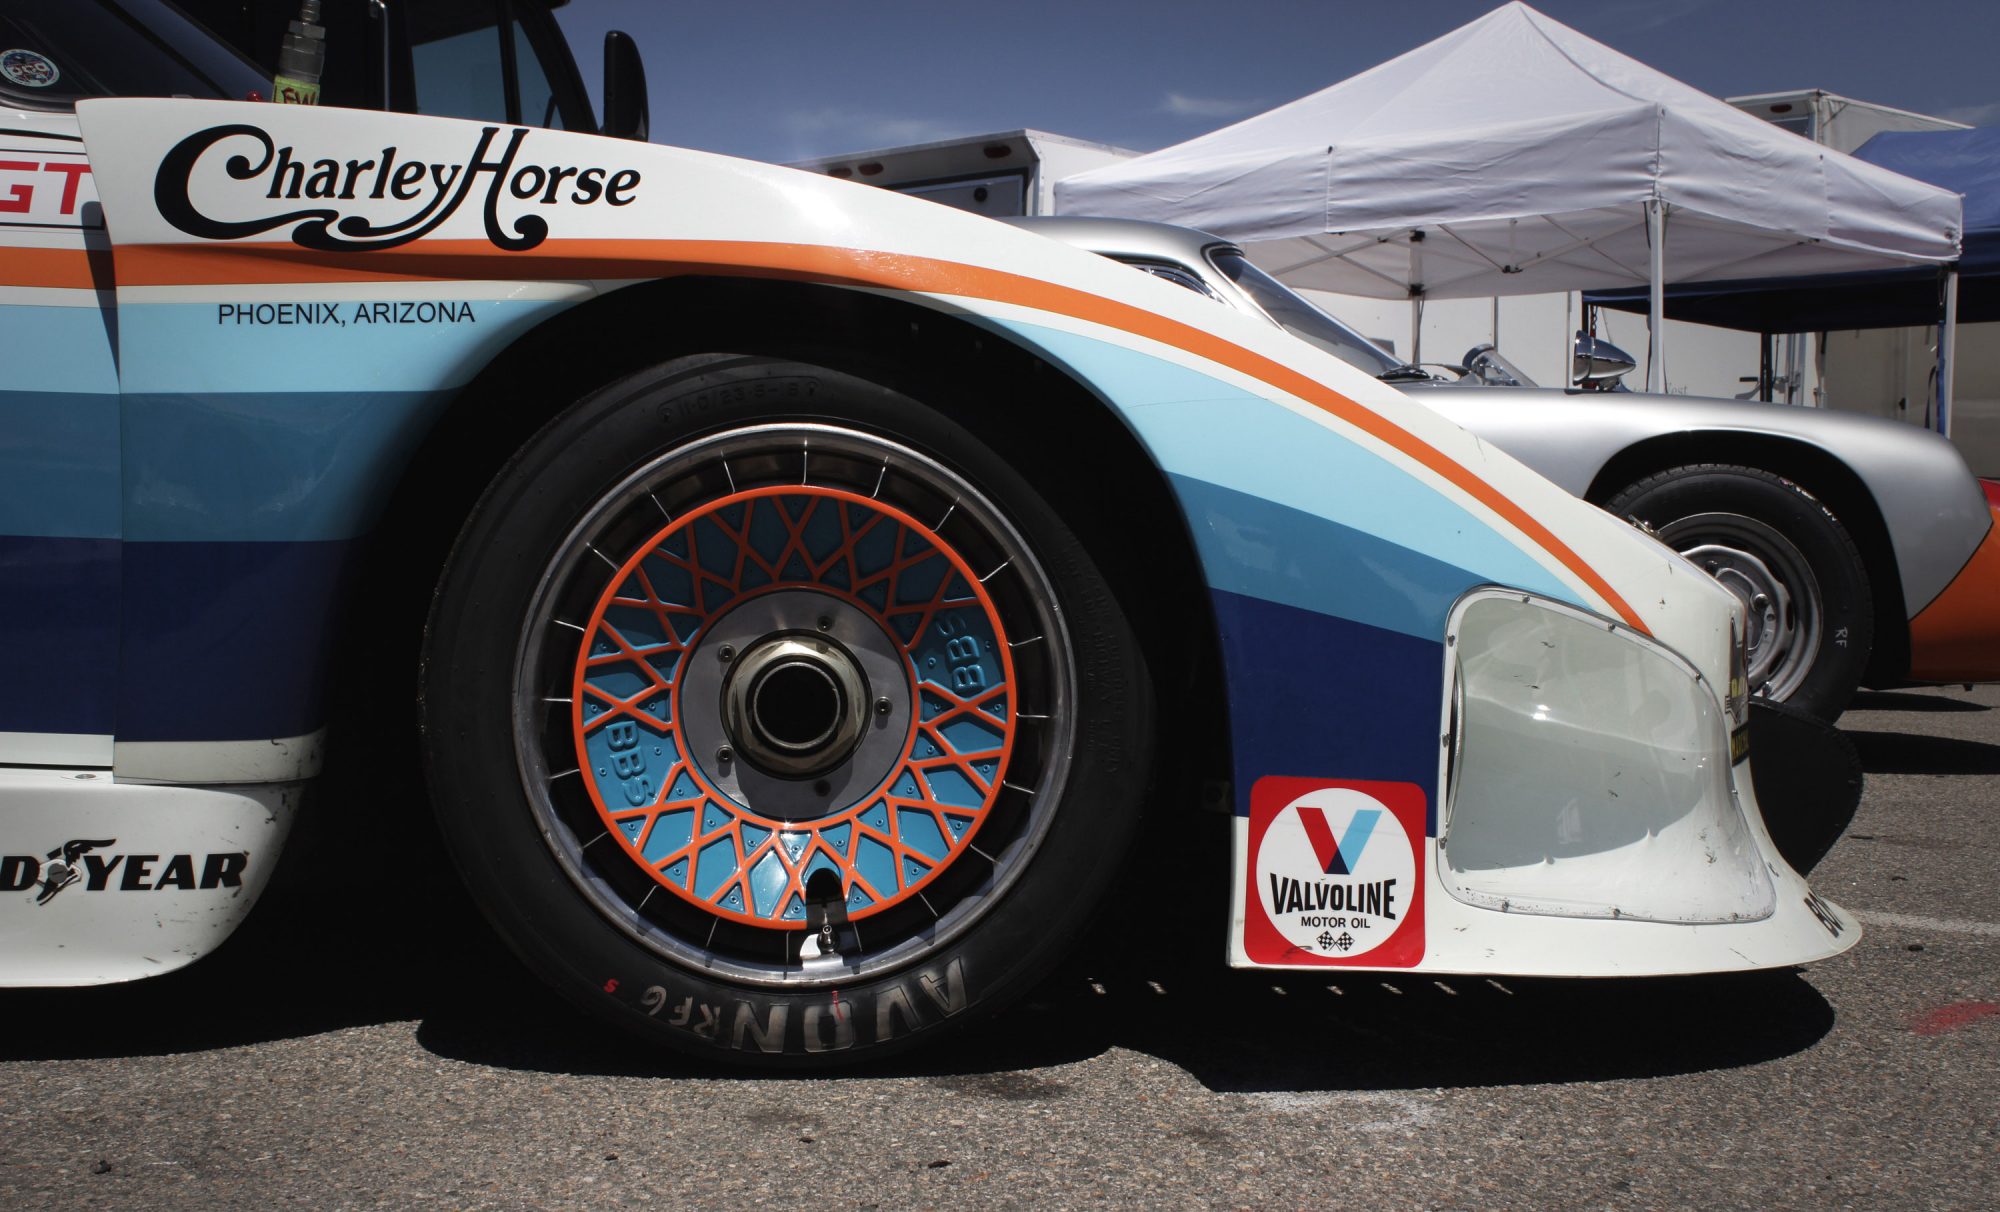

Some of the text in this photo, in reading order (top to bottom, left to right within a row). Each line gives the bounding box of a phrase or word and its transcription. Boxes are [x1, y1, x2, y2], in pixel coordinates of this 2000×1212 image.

[217, 302, 475, 327] PHOENIX, ARIZONA
[936, 612, 986, 690] BBS
[1835, 626, 1848, 648] RF
[606, 720, 656, 807] BBS
[1270, 872, 1396, 921] VALVOLINE
[1301, 916, 1370, 929] MOTOR OIL
[731, 956, 968, 1053] AVON
